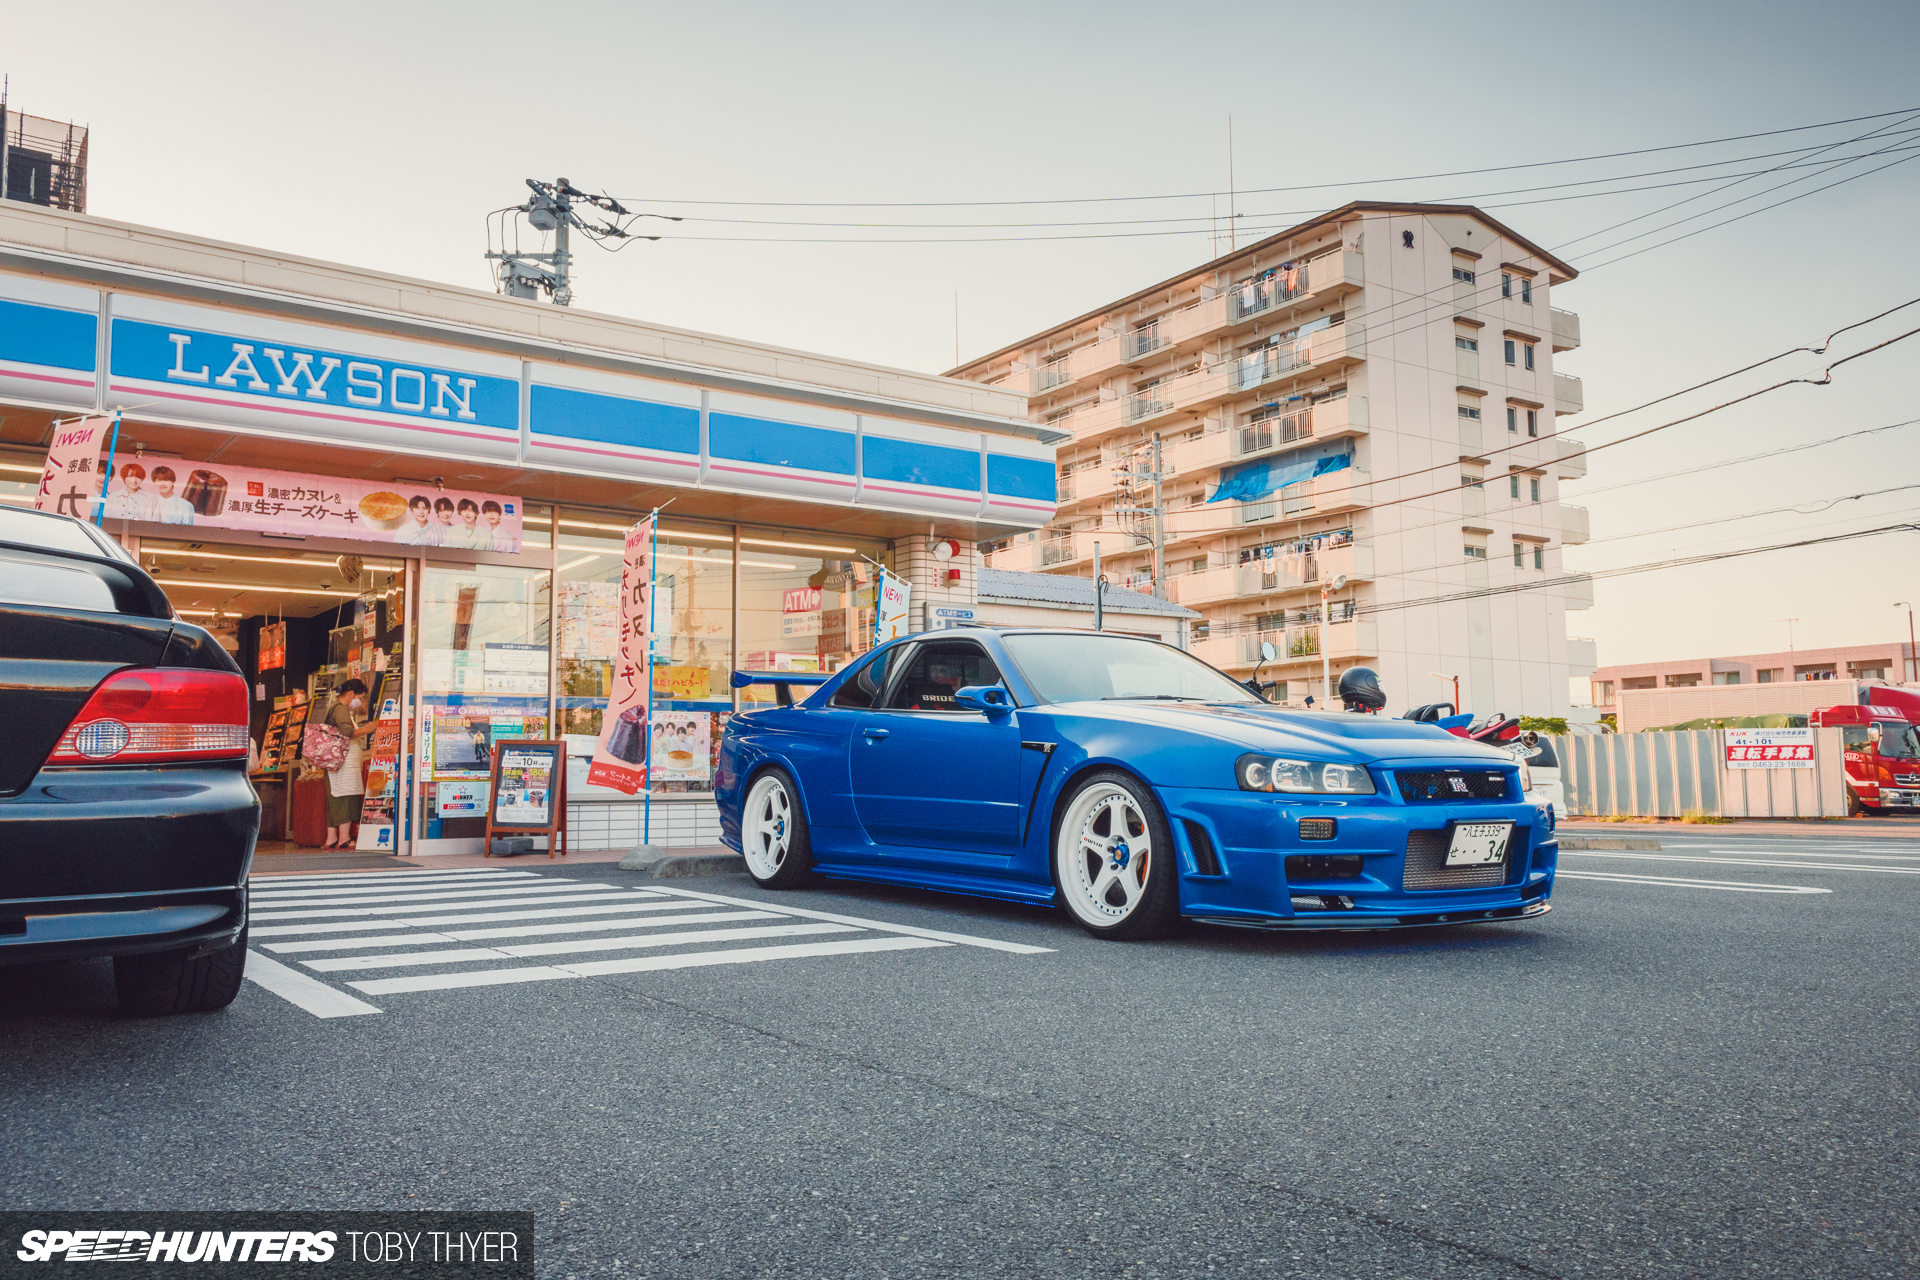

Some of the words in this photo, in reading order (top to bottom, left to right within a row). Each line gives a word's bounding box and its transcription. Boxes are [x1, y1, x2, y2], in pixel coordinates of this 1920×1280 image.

[168, 333, 477, 420] LAWSON
[268, 486, 341, 504] 濃密カヌレ&
[228, 499, 359, 523] 濃厚生チーズケーキ
[784, 589, 812, 612] ATM
[883, 586, 904, 606] NEW!
[937, 609, 972, 618] ATMサービス
[921, 694, 956, 702] BRIDE
[477, 707, 492, 715] LIVE
[1730, 746, 1811, 760] 運転手募集
[372, 756, 396, 767] NEW!
[1450, 847, 1458, 857] せ
